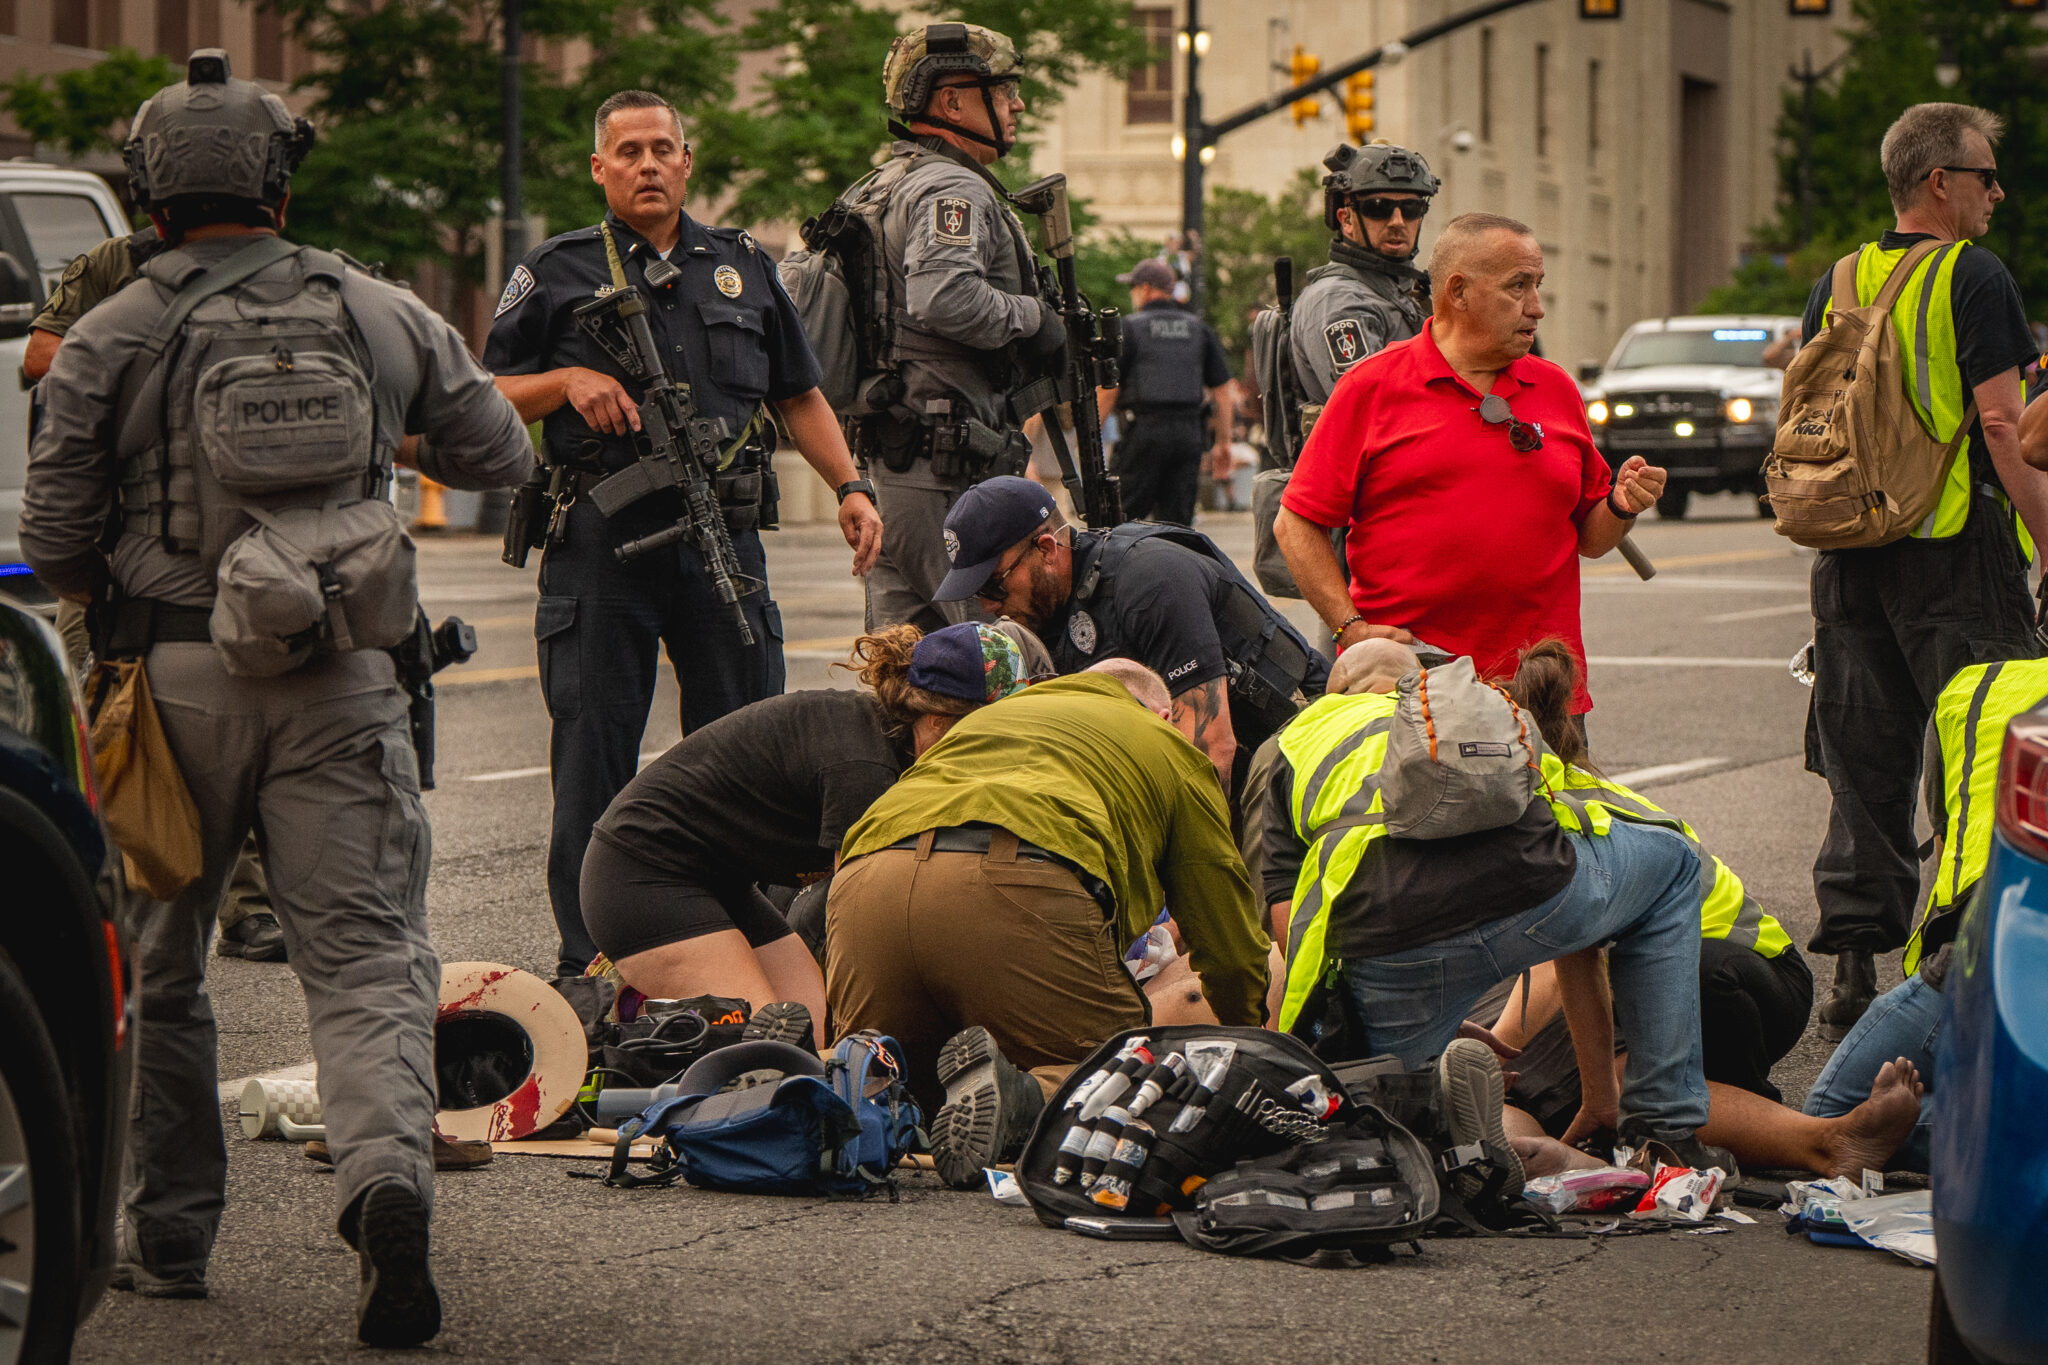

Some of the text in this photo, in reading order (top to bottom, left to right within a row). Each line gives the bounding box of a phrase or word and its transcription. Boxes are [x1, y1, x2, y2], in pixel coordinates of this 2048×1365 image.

[243, 395, 339, 424] POLICE
[1792, 423, 1826, 436] NRA
[1168, 660, 1199, 680] POLICE
